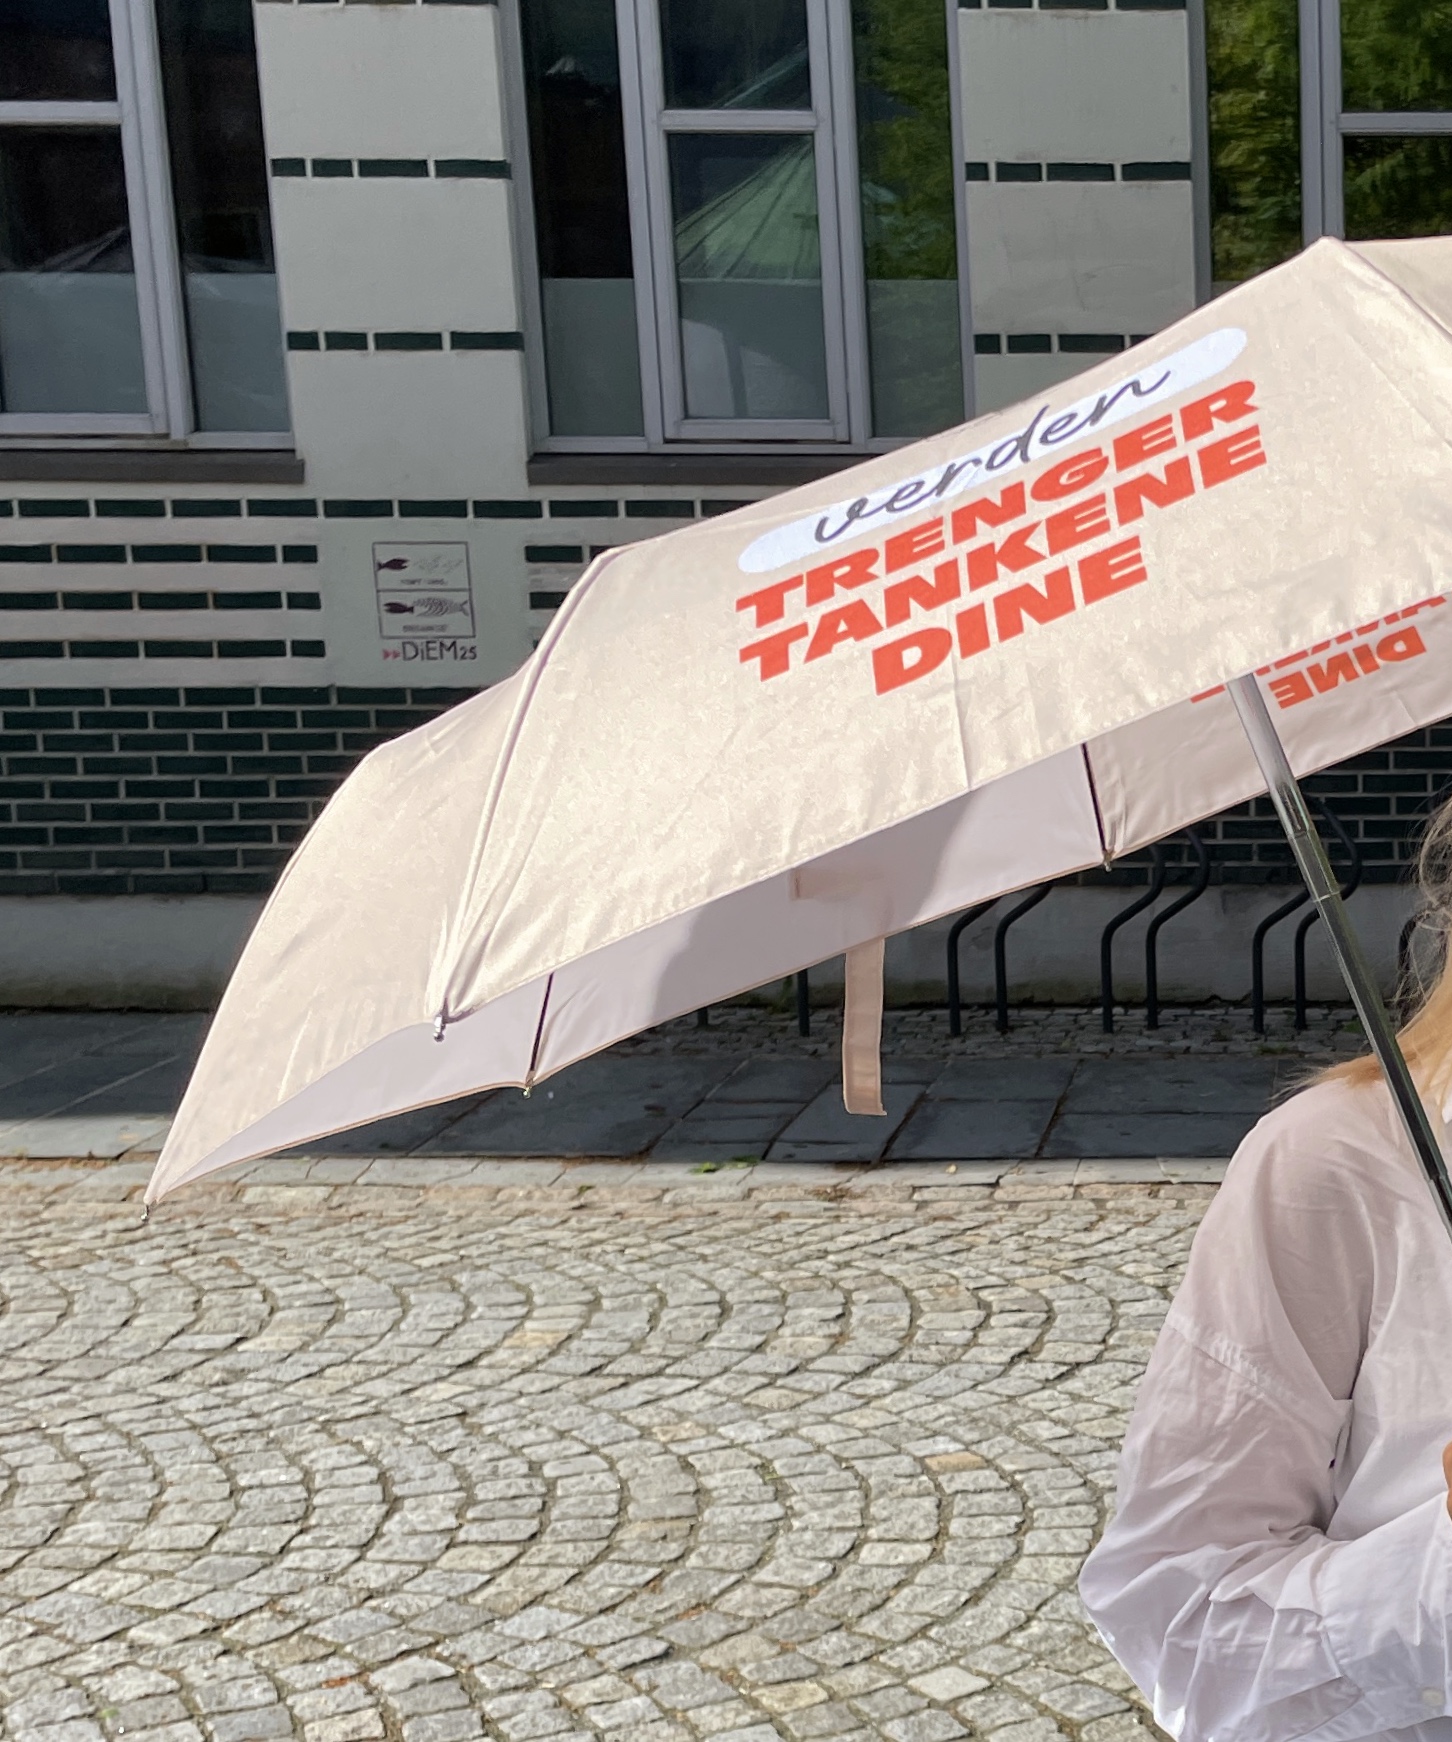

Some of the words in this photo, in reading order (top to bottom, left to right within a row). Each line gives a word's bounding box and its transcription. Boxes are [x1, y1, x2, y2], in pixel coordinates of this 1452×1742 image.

[736, 379, 1260, 628] TRENGER
[739, 424, 1267, 682] TANKENE
[814, 370, 1172, 543] verden
[871, 535, 1148, 696] DINE
